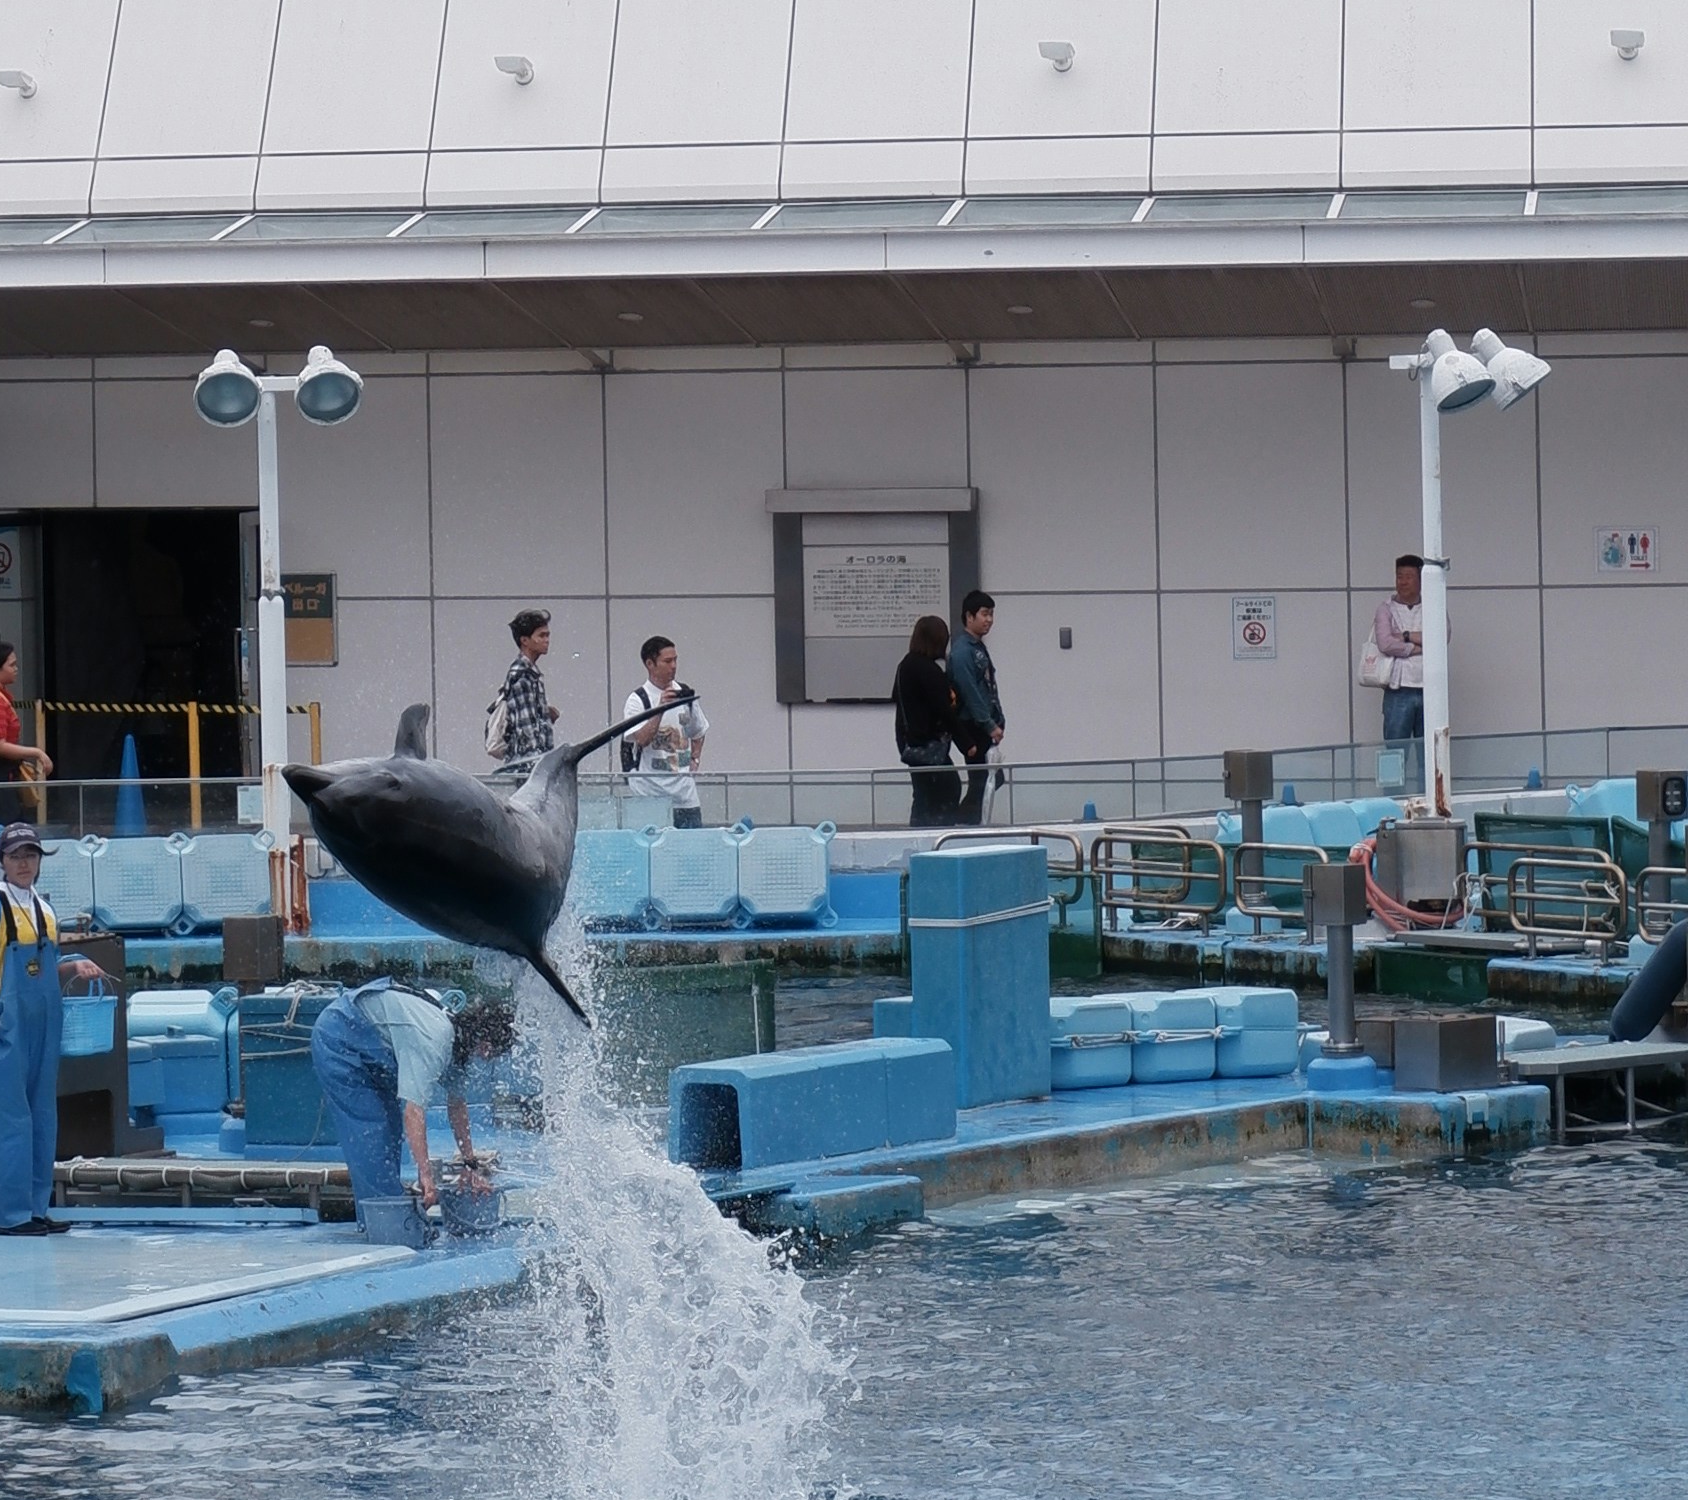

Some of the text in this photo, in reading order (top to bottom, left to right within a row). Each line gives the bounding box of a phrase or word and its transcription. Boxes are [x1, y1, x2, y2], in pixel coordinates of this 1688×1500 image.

[845, 555, 907, 565] オーロラの海
